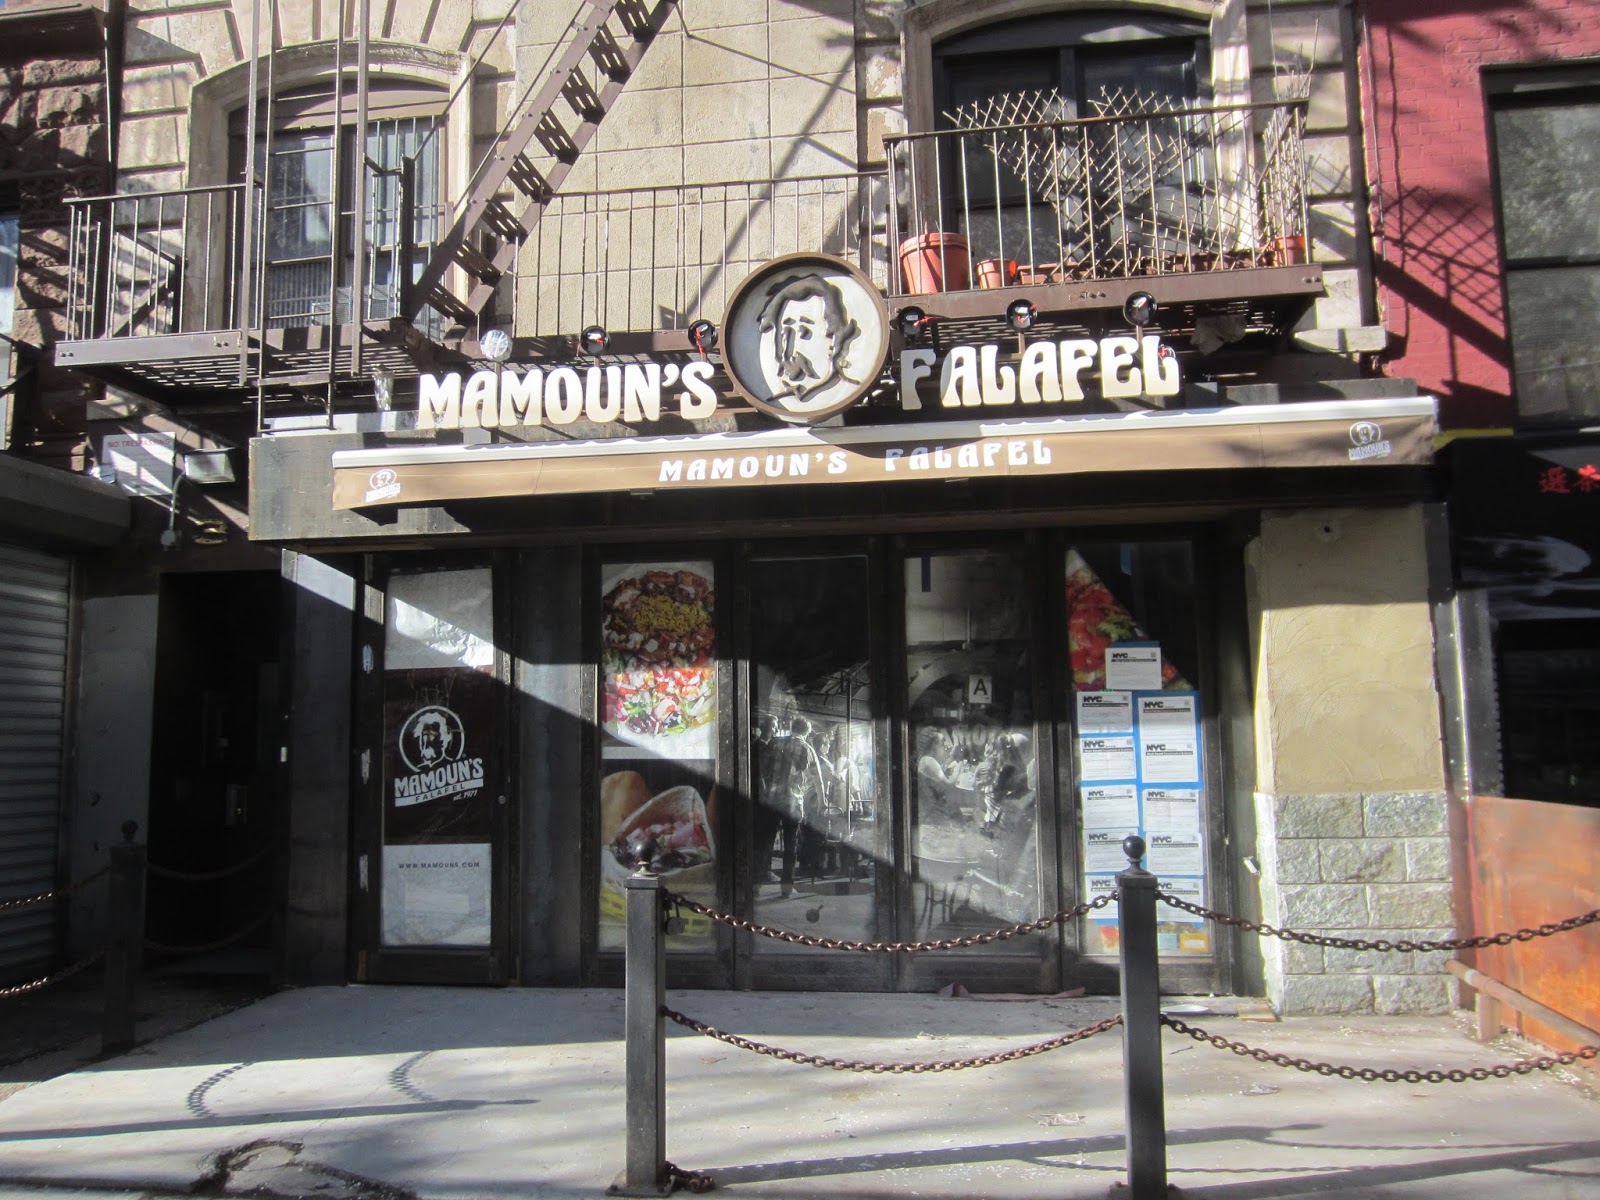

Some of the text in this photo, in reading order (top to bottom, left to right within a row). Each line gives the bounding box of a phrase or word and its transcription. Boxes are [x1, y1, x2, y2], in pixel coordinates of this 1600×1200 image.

[417, 335, 1180, 430] MAMOUN'S FALAFEL
[108, 440, 119, 448] NO
[658, 439, 1052, 483] MAMOUN'S FALAFEL
[973, 678, 988, 696] A
[1083, 740, 1105, 748] NYC
[394, 757, 484, 797] MAMOUN'S
[415, 783, 466, 802] FALAFEL
